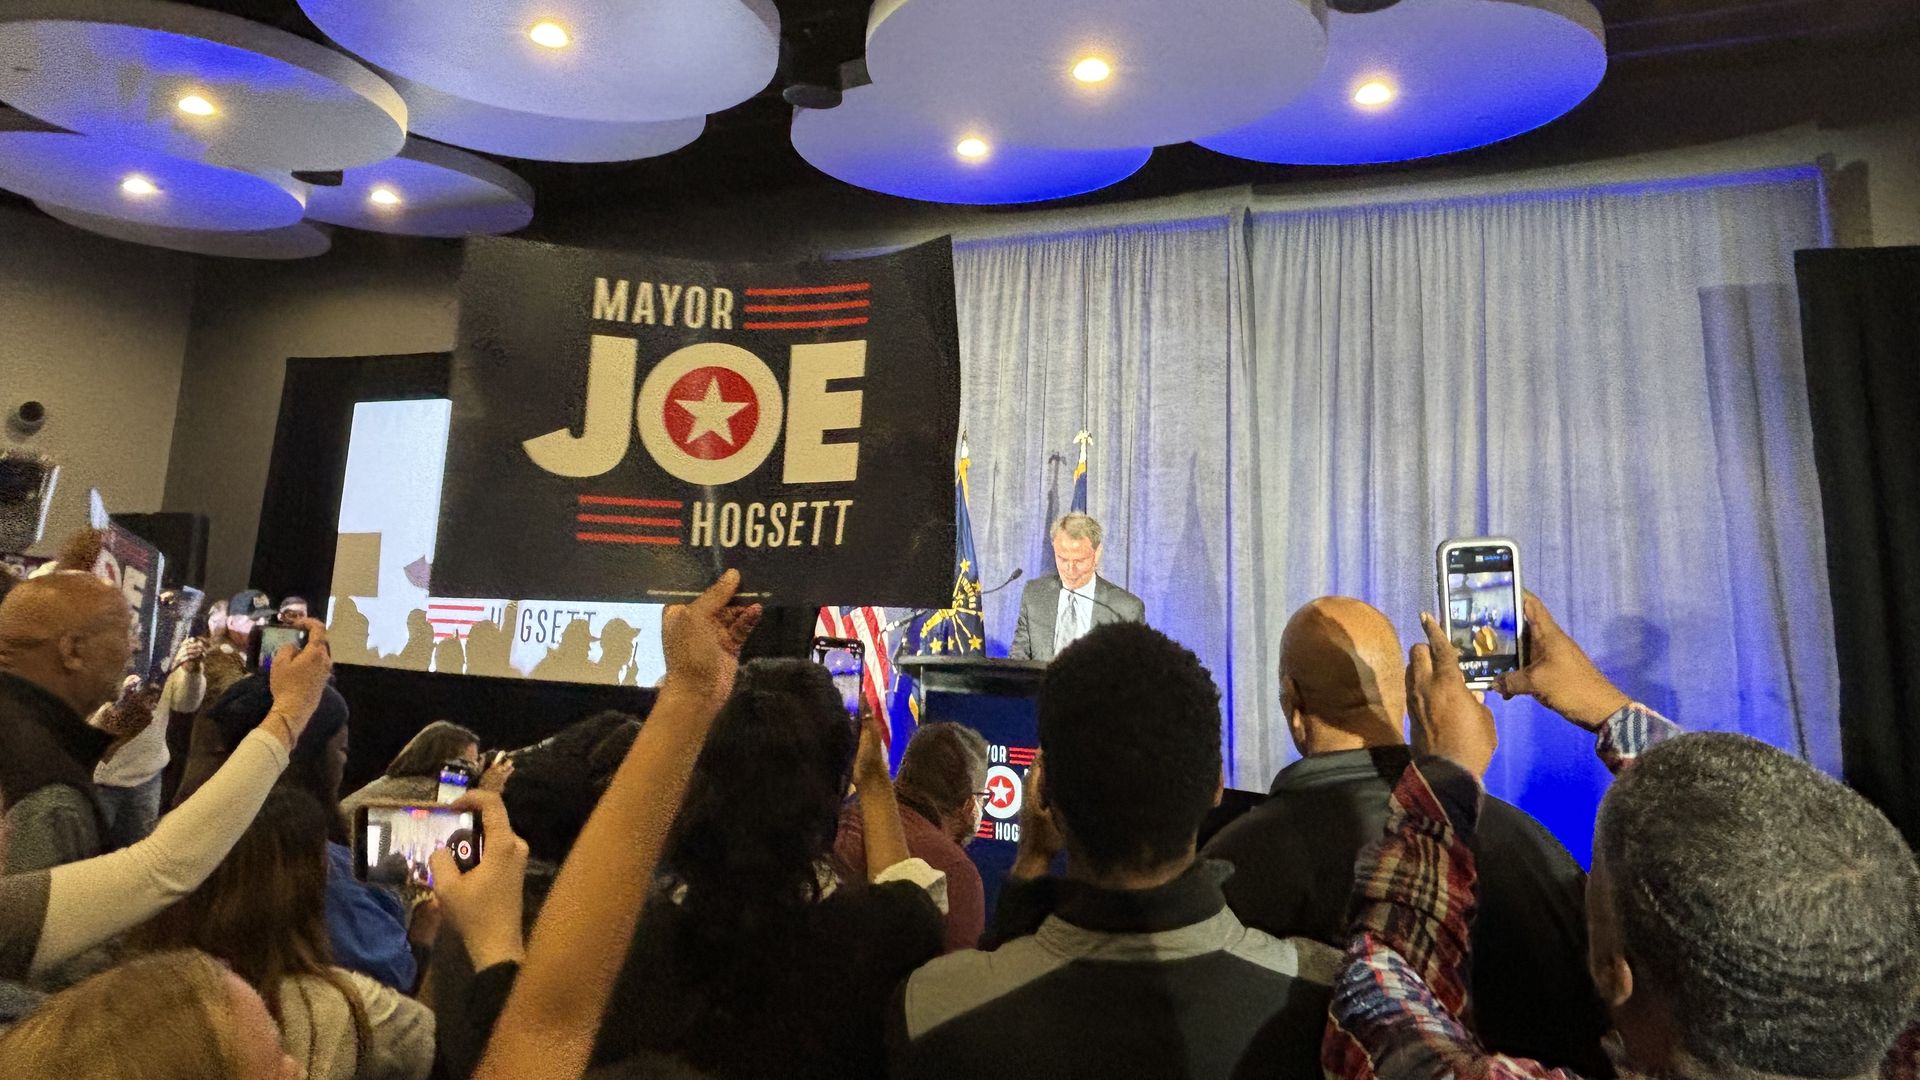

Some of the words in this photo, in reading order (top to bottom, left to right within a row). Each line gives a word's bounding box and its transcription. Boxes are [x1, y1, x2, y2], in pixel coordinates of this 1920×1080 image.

[592, 277, 734, 330] MAYOR
[522, 334, 867, 486] JOE
[690, 499, 853, 548] HOGSETT
